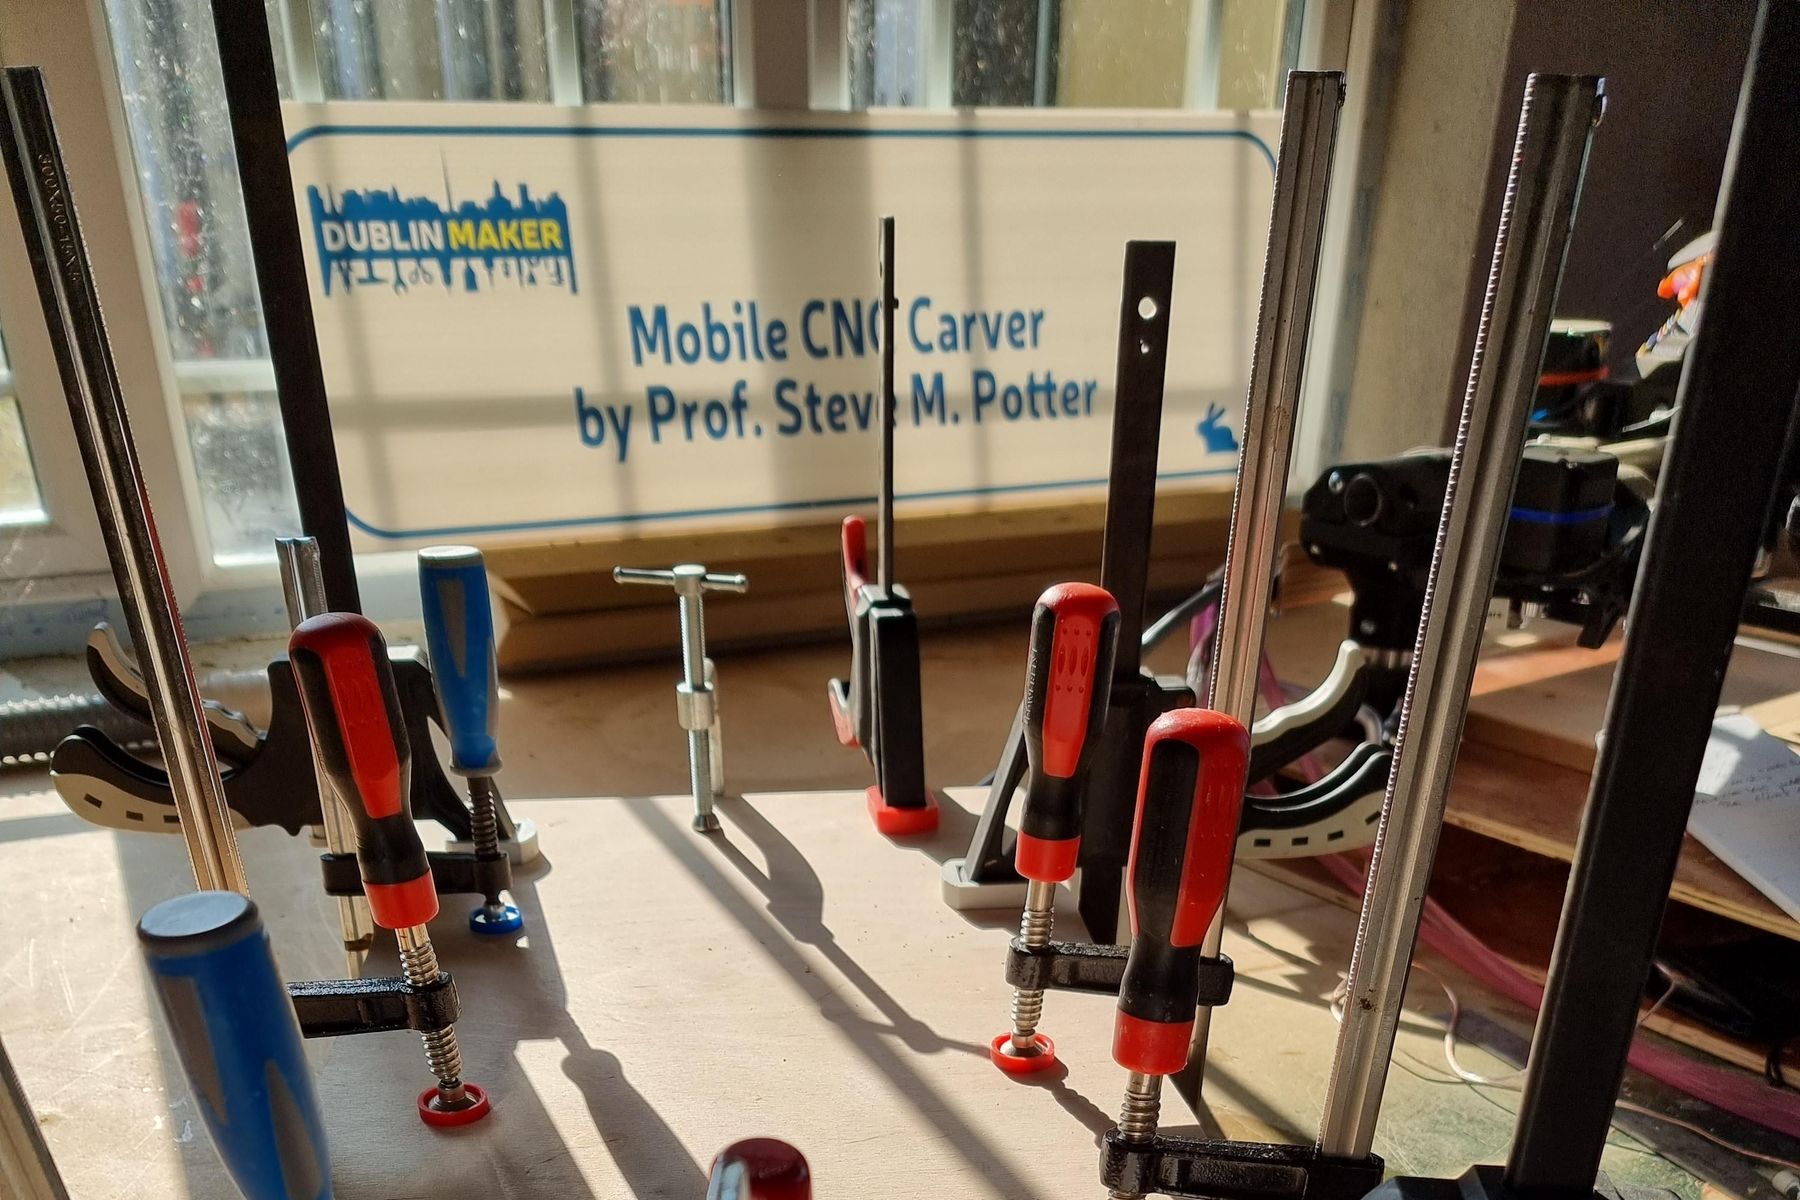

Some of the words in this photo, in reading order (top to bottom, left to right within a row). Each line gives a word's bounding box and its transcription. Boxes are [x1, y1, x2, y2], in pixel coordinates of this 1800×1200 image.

[321, 220, 444, 251] DUBLIN
[446, 219, 563, 249] MAKER
[629, 303, 787, 364] Mobile
[908, 297, 1045, 352] Carver
[576, 388, 631, 462] by
[647, 381, 762, 443] Prof.
[912, 371, 960, 425] M.
[974, 370, 1098, 424] Potter
